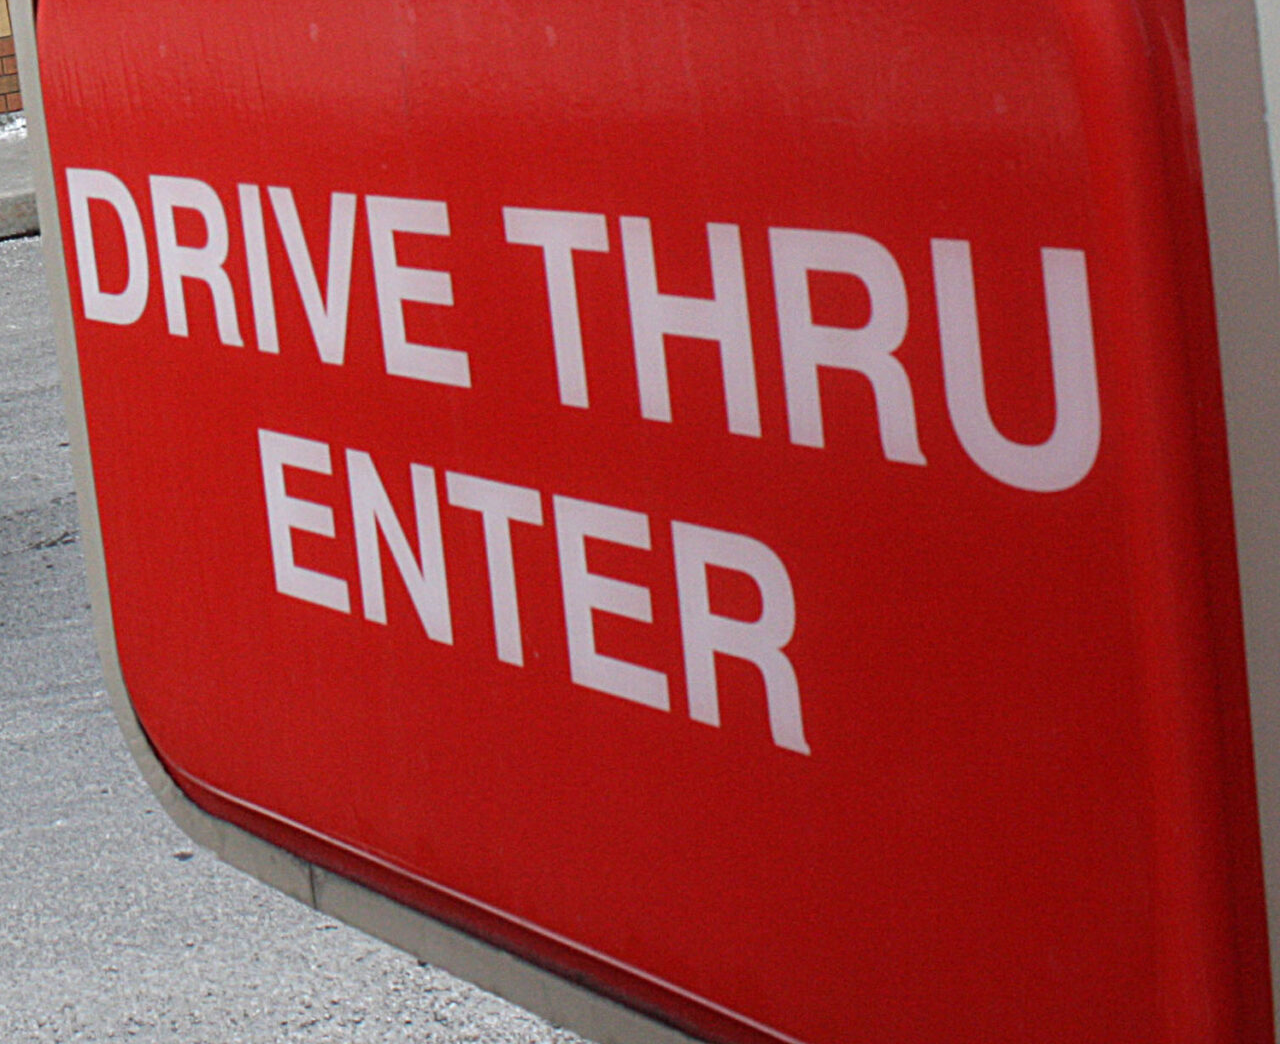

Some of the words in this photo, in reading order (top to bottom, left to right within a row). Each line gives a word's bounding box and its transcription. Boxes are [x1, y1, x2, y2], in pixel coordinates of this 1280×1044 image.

[65, 167, 472, 388] DRIVE
[502, 206, 1102, 493] THRU
[257, 427, 811, 756] ENTER
